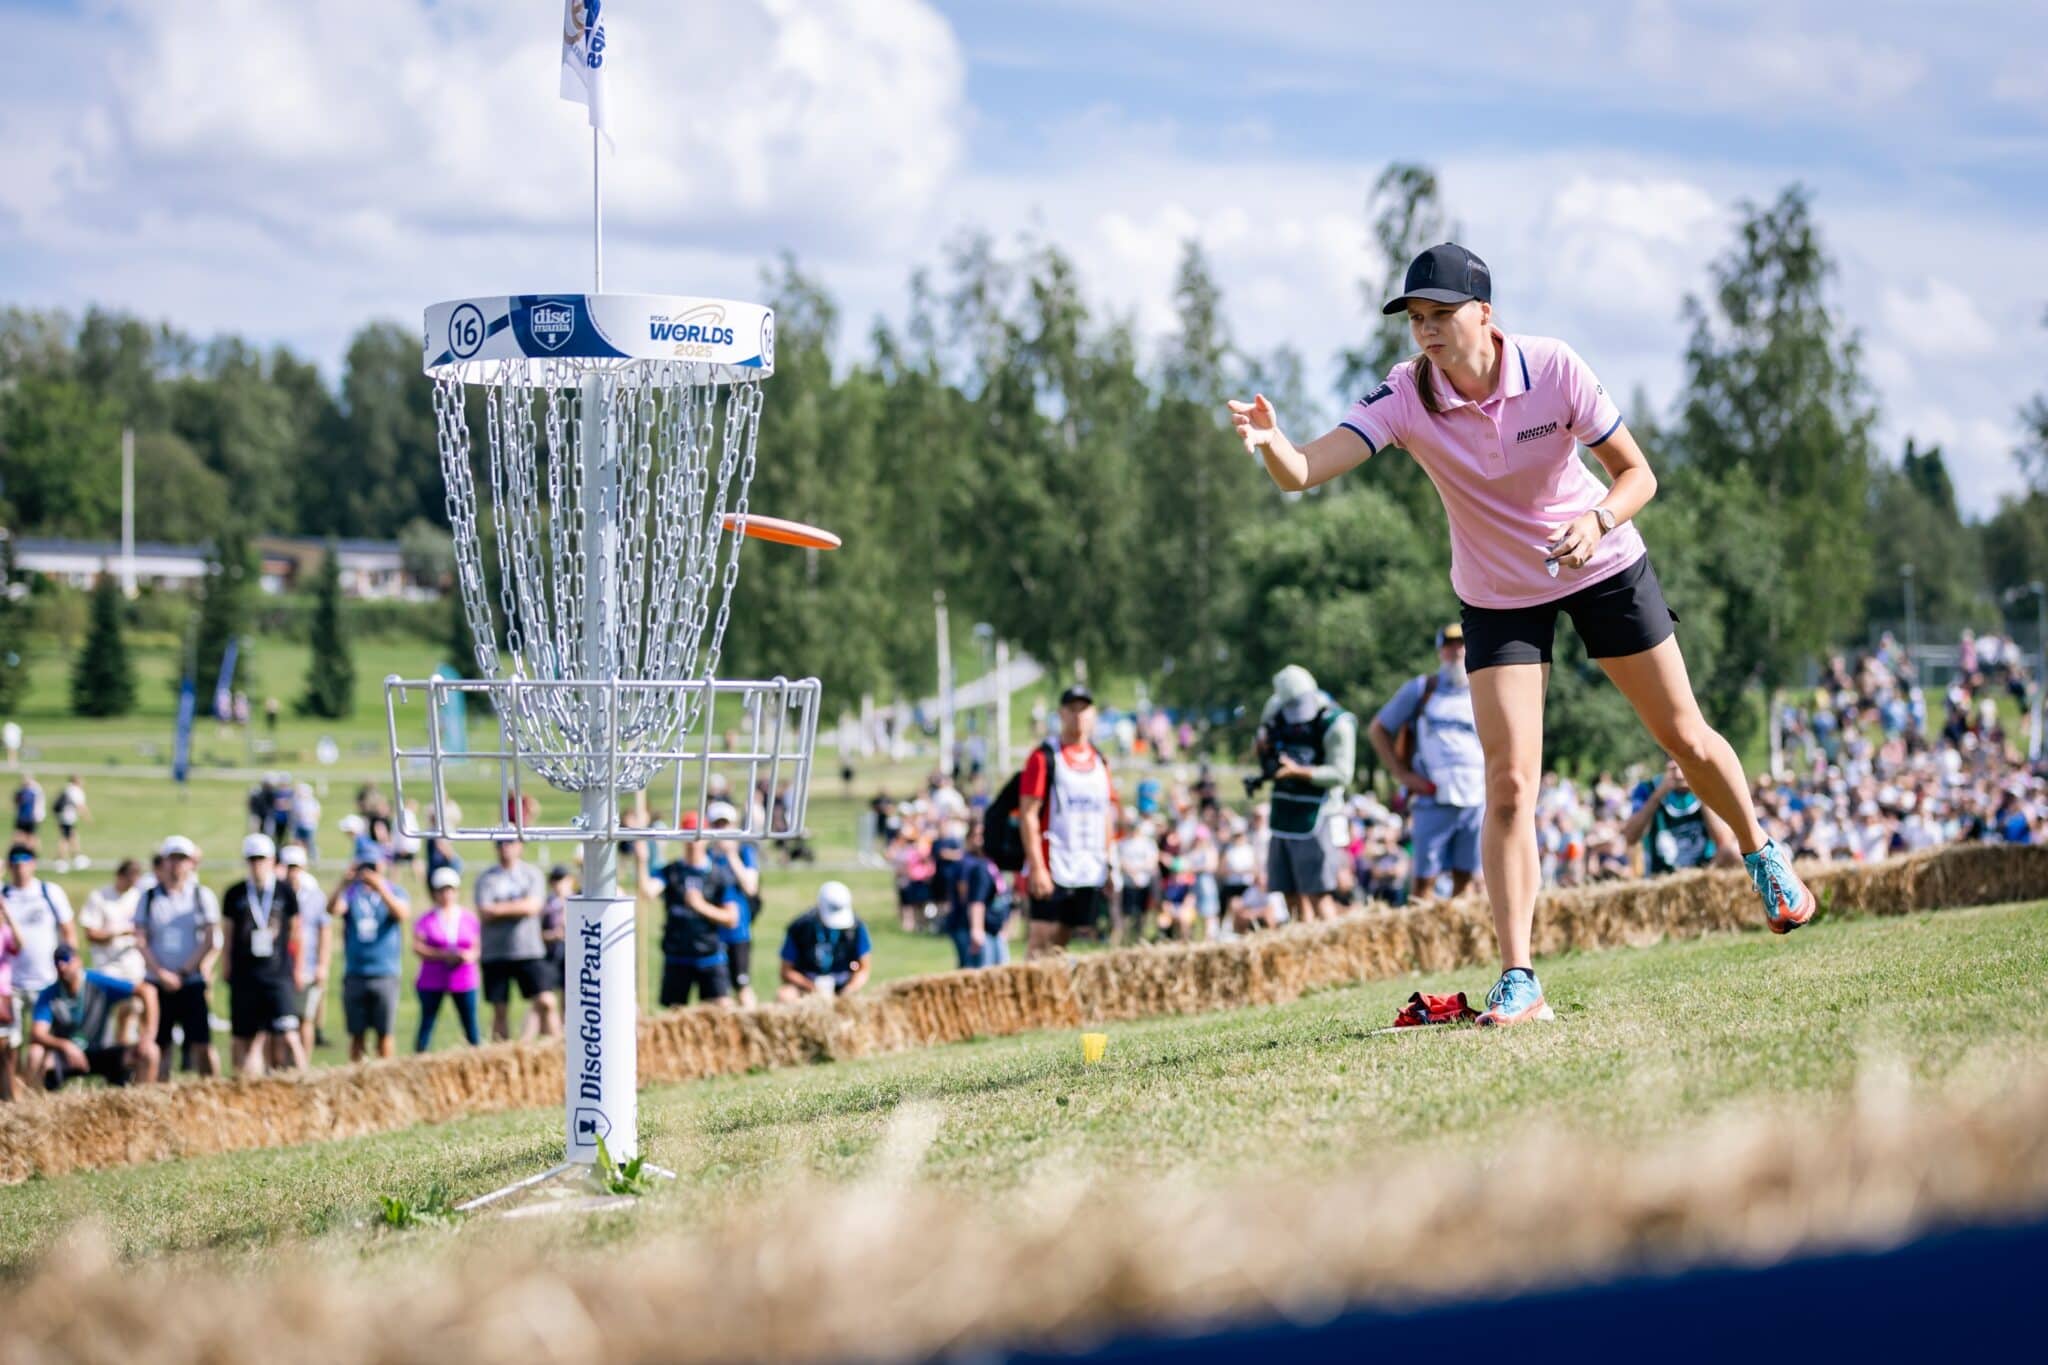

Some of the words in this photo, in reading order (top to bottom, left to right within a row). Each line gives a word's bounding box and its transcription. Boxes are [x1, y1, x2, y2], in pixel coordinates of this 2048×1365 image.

[534, 309, 571, 324] disc
[454, 317, 478, 346] 16
[534, 324, 570, 332] mania
[650, 323, 734, 345] WORLDS
[674, 344, 713, 358] 2025
[1517, 421, 1557, 441] INNOVA
[580, 920, 602, 1102] DiscGolfPark
